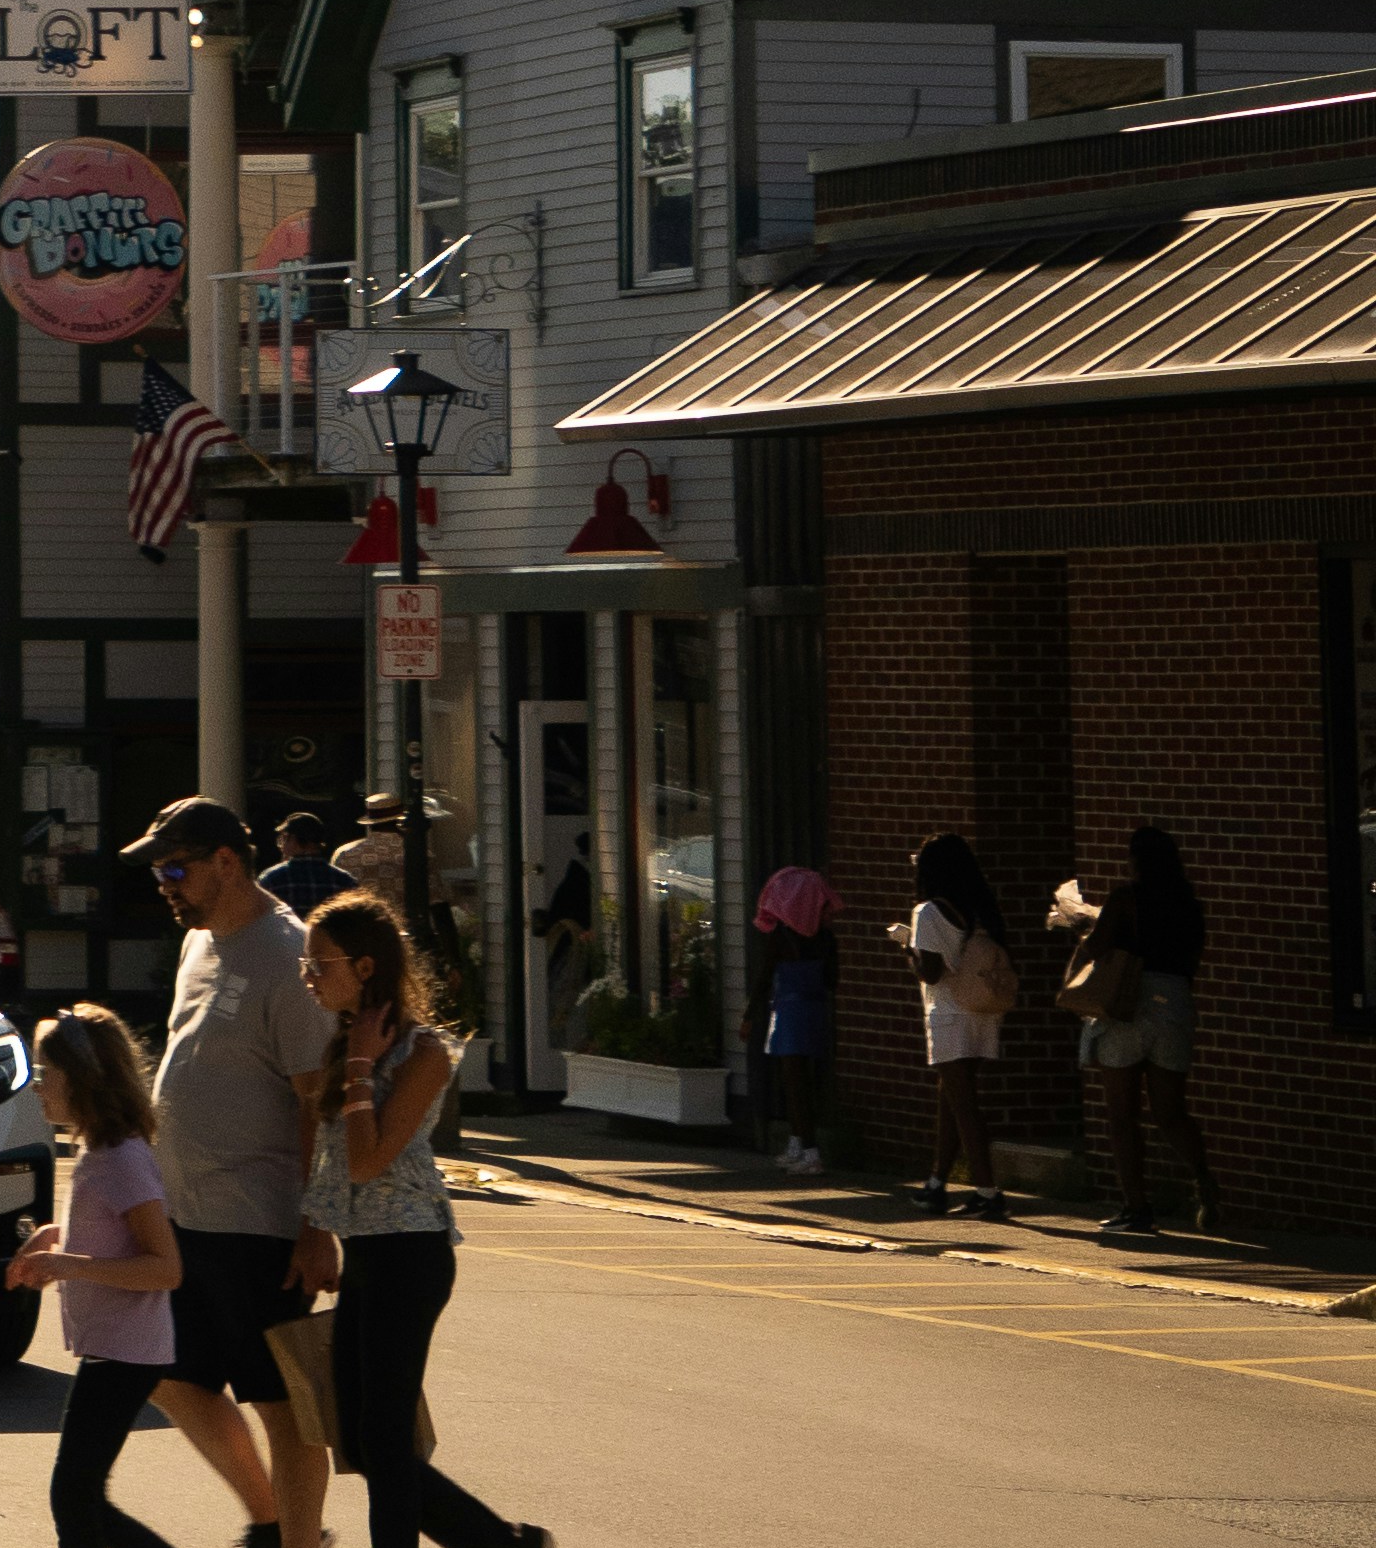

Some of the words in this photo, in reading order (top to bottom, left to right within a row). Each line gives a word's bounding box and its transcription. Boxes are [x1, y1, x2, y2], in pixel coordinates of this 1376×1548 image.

[397, 592, 421, 613] NO
[380, 617, 439, 637] PARKING
[383, 638, 436, 652] LOADING
[394, 653, 425, 667] ZONE
